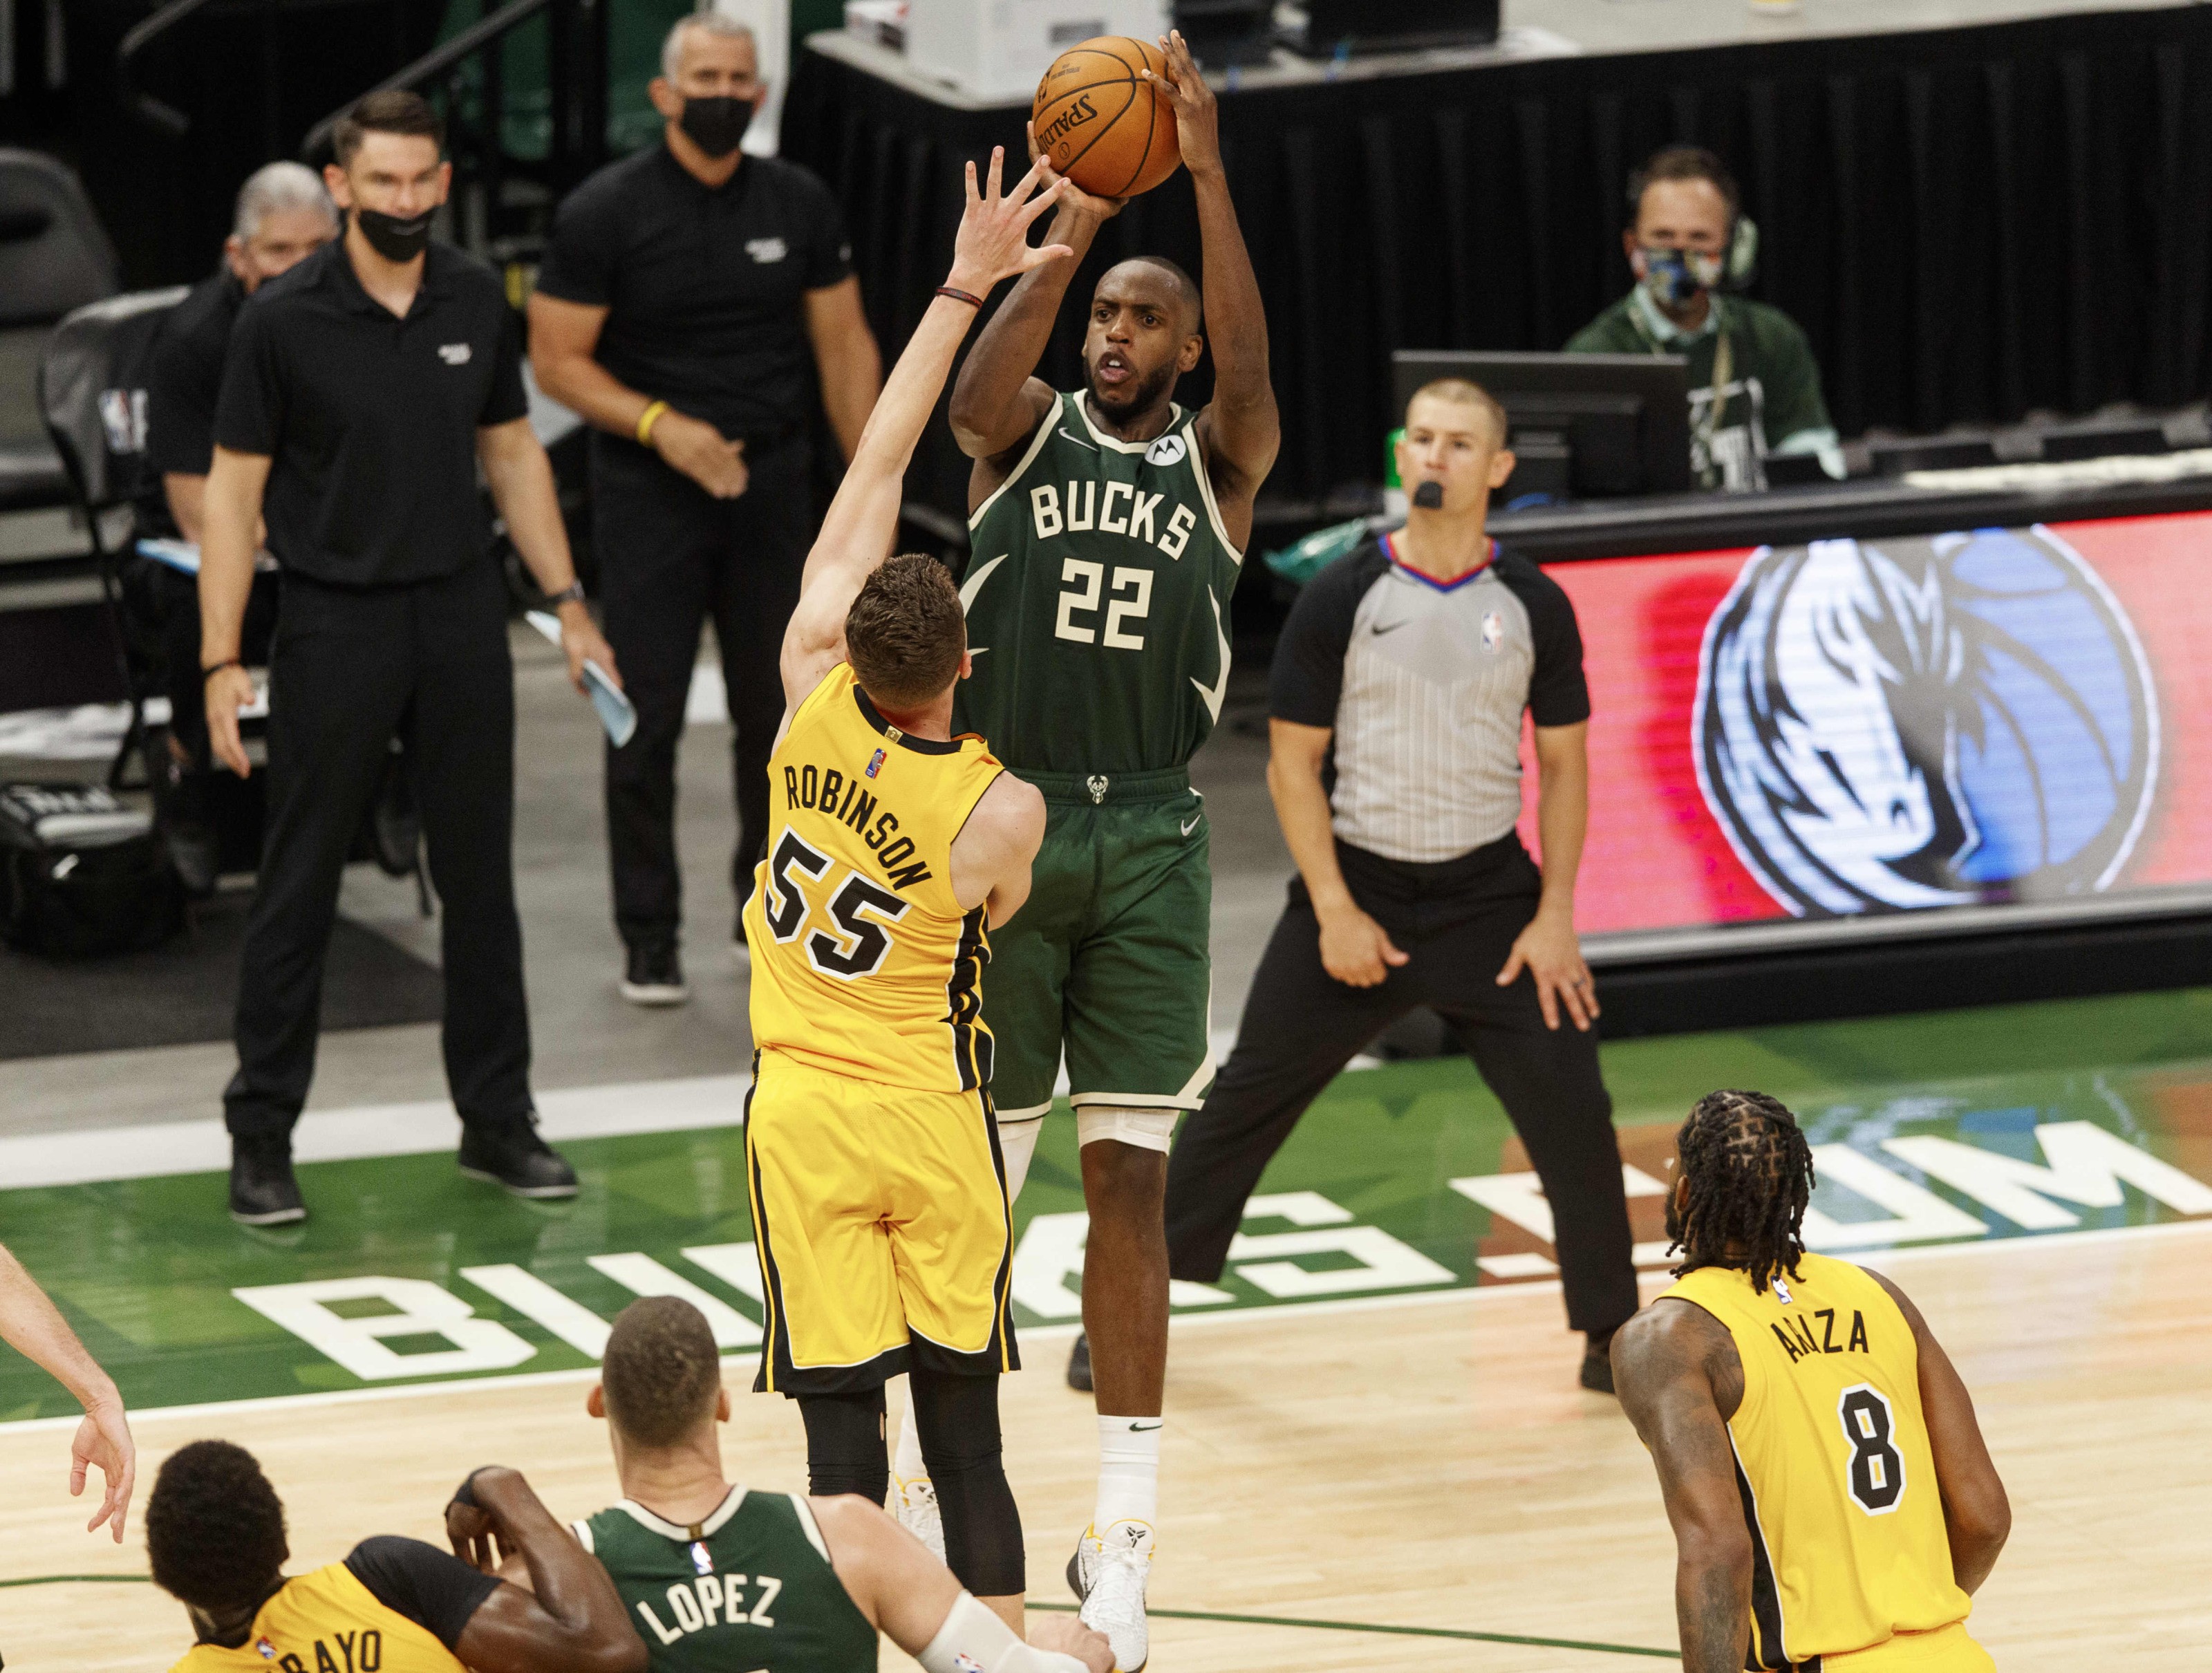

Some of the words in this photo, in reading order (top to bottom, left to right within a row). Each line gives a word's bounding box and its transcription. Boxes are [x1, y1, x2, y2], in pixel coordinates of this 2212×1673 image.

[1030, 480, 1197, 561] BUCKS
[1055, 557, 1154, 651] 22
[784, 764, 932, 891] ROBINSON
[764, 823, 913, 982] 55
[1836, 1381, 1907, 1517] 8
[267, 1630, 382, 1673] BAYO
[636, 1573, 782, 1645] LOPEZ
